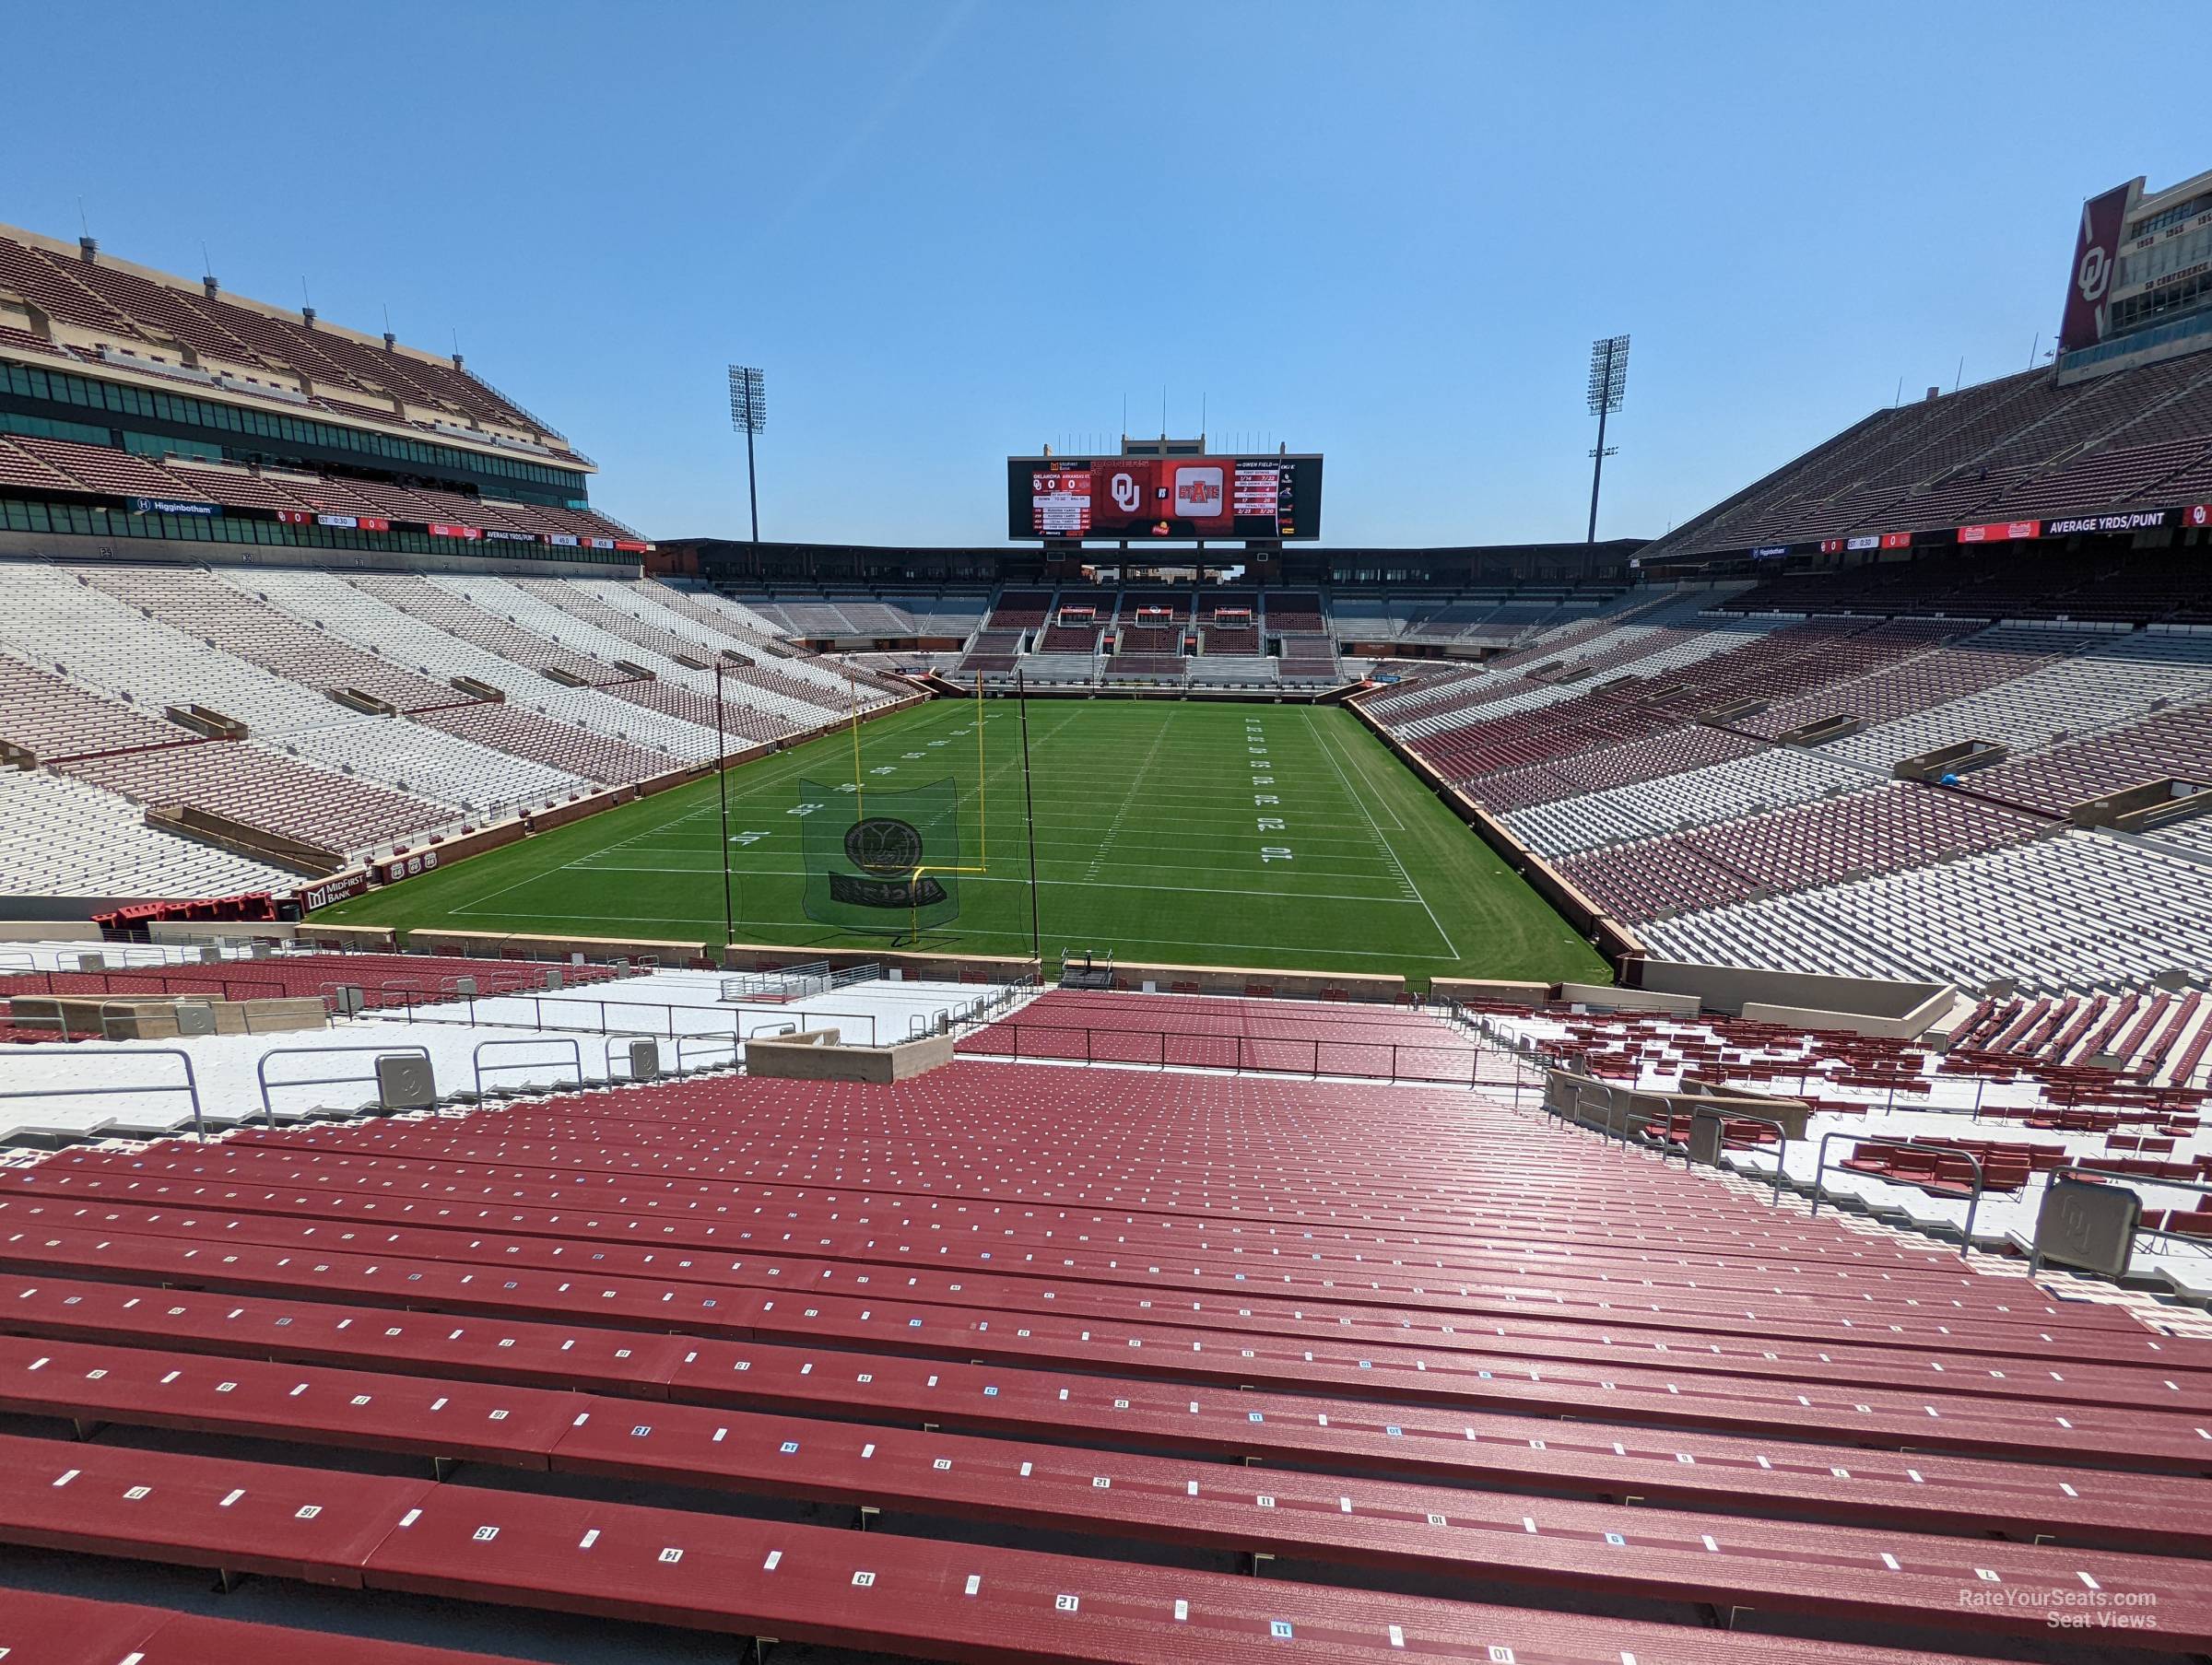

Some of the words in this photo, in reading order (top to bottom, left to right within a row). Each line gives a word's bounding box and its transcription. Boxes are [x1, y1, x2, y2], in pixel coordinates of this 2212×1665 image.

[2198, 213, 2212, 225] 195
[2078, 246, 2112, 301] OU
[1048, 480, 1054, 488] 0
[1068, 480, 1075, 488] 0
[1112, 474, 1139, 511] OU
[155, 501, 211, 514] Higginbotham
[295, 513, 300, 522] 0
[2194, 506, 2206, 523] OU
[334, 517, 347, 525] 0:30
[369, 520, 374, 528] 0
[2050, 518, 2097, 534] AVERAGE
[2099, 512, 2165, 530] YRDS/PUNT
[487, 531, 509, 540] AVERAGE
[1860, 538, 1872, 546] 0:30
[1890, 536, 1895, 545] 0
[1831, 541, 1836, 550] 0
[1257, 818, 1285, 829] 20
[729, 831, 771, 842] 10
[1261, 848, 1292, 859] 10
[410, 862, 419, 871] 66
[427, 858, 436, 866] 66
[393, 868, 402, 876] 66
[1681, 1455, 1689, 1463] 8
[1263, 1498, 1270, 1507] 11
[301, 1507, 317, 1516] 16
[1432, 1517, 1442, 1526] 10
[477, 1529, 496, 1538] 15
[1610, 1535, 1620, 1544] 9
[665, 1551, 678, 1560] 14
[857, 1575, 870, 1584] 13
[1985, 1571, 1996, 1580] 7
[1057, 1597, 1076, 1610] 12
[1277, 1623, 1290, 1635] 11
[1494, 1648, 1510, 1661] 10
